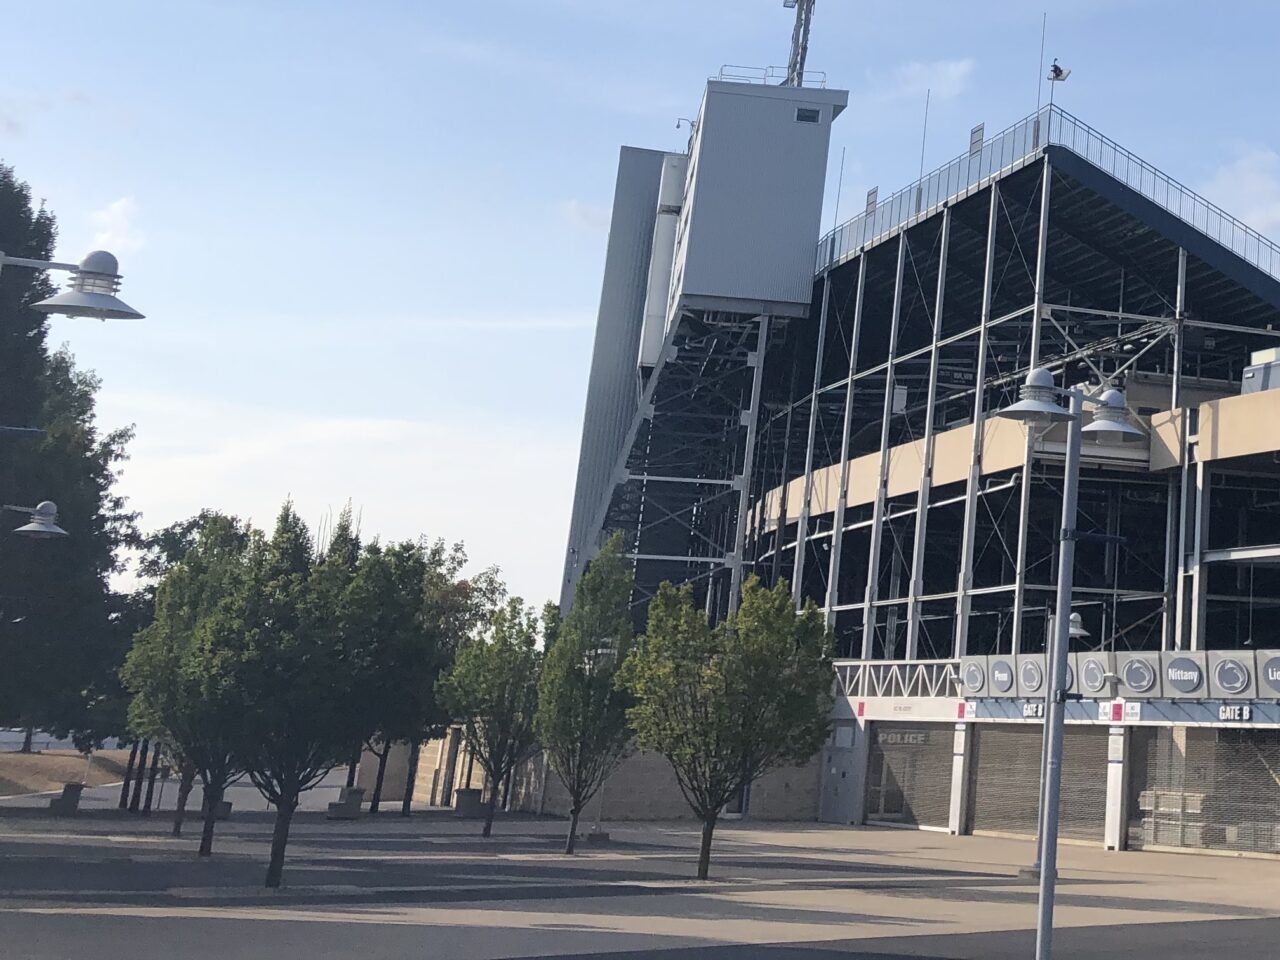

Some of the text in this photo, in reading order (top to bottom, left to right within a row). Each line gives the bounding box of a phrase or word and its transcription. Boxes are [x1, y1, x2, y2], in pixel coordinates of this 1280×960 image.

[1168, 668, 1199, 683] Nittany
[1023, 703, 1037, 717] GATE
[1219, 706, 1250, 720] GATE B
[878, 732, 925, 744] POLICE
